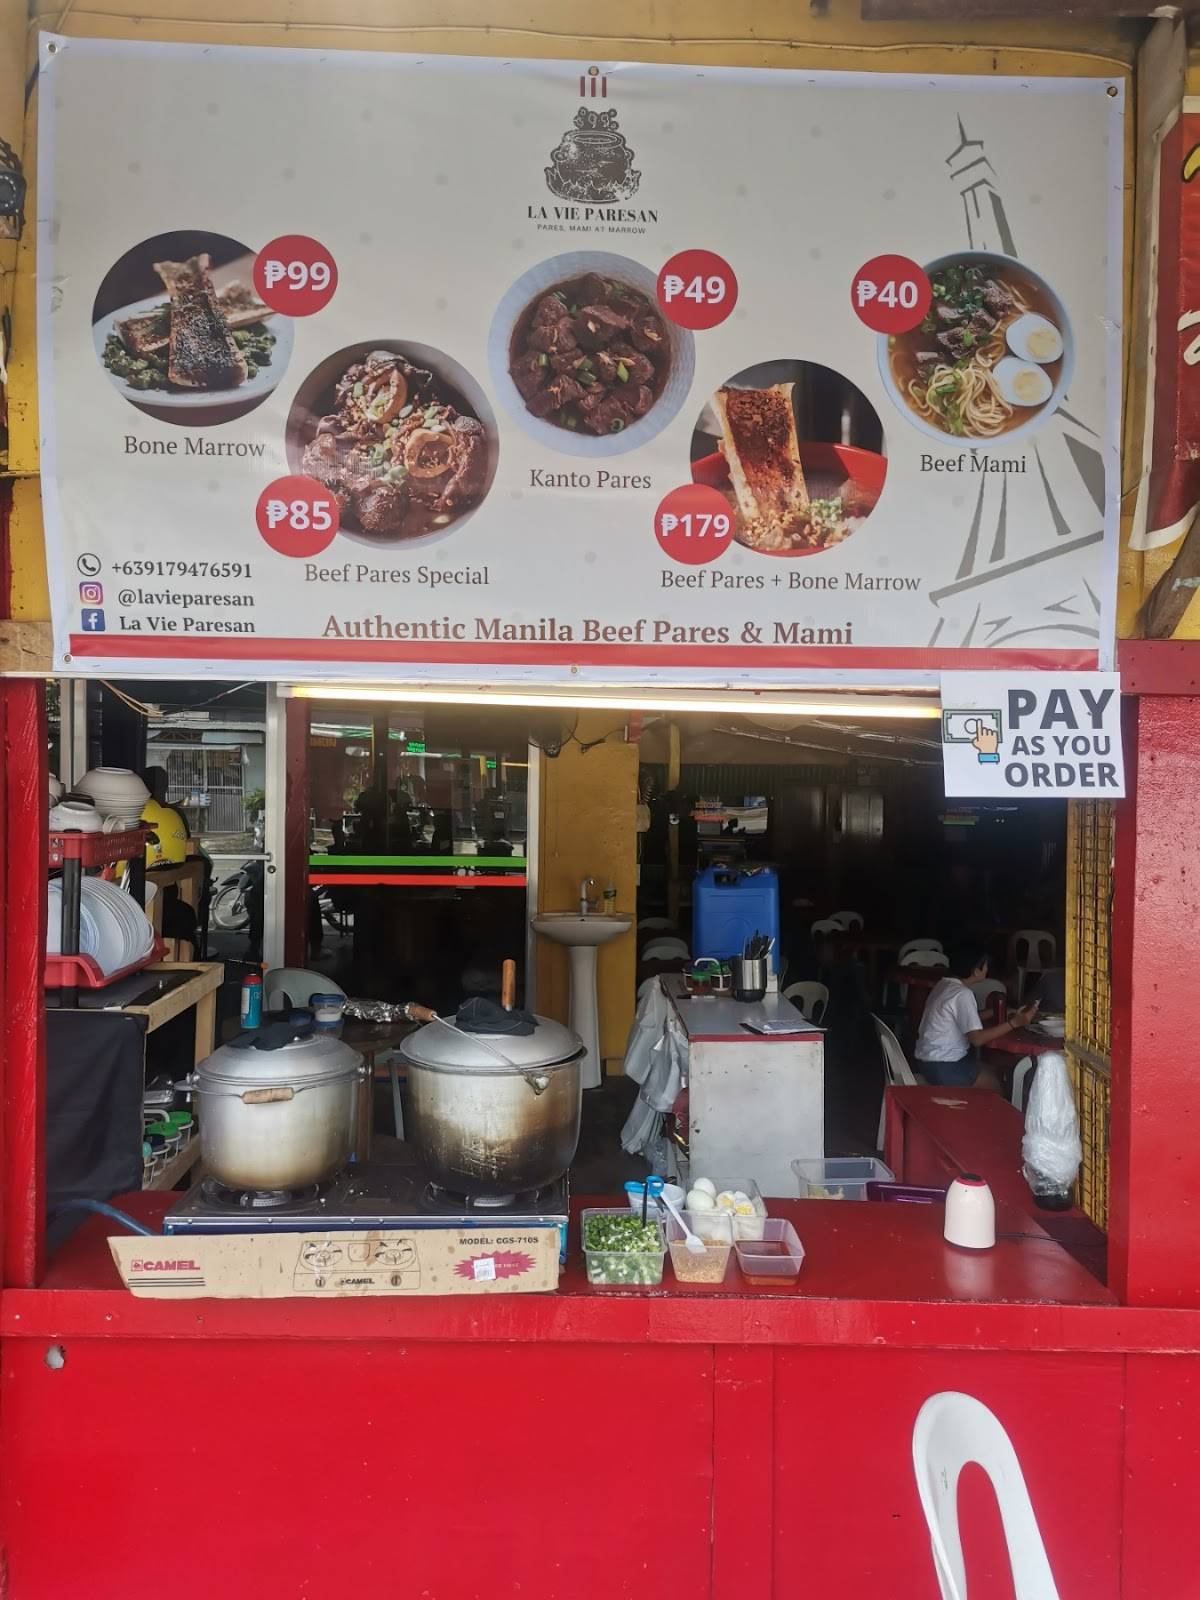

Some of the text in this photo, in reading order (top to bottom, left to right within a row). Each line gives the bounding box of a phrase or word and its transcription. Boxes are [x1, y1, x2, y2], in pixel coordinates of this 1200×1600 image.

[528, 206, 658, 222] LA VIE PARESAN
[608, 226, 646, 234] MARROW
[264, 260, 330, 290] ₱99
[663, 275, 726, 303] ₱49
[856, 280, 918, 308] ₱40
[125, 436, 265, 457] Bone Marrow
[920, 454, 1026, 473] Beef Mami
[530, 469, 651, 489] Kanto Pares
[266, 500, 332, 530] ₱85
[661, 513, 729, 538] ₱179
[112, 561, 252, 577] +639179476591
[305, 564, 490, 587] Beef Pares Special
[661, 570, 921, 591] Beef Pares + Bone Marrow
[118, 589, 255, 608] @lavieparesan
[120, 616, 255, 633] La Vie Paresan
[322, 614, 853, 645] Authentic Manila Beef Pares & Mami
[1008, 689, 1115, 729] PAY
[1012, 736, 1110, 755] AS YOU
[1005, 762, 1119, 787] ORDER
[143, 1260, 200, 1271] CAMEL
